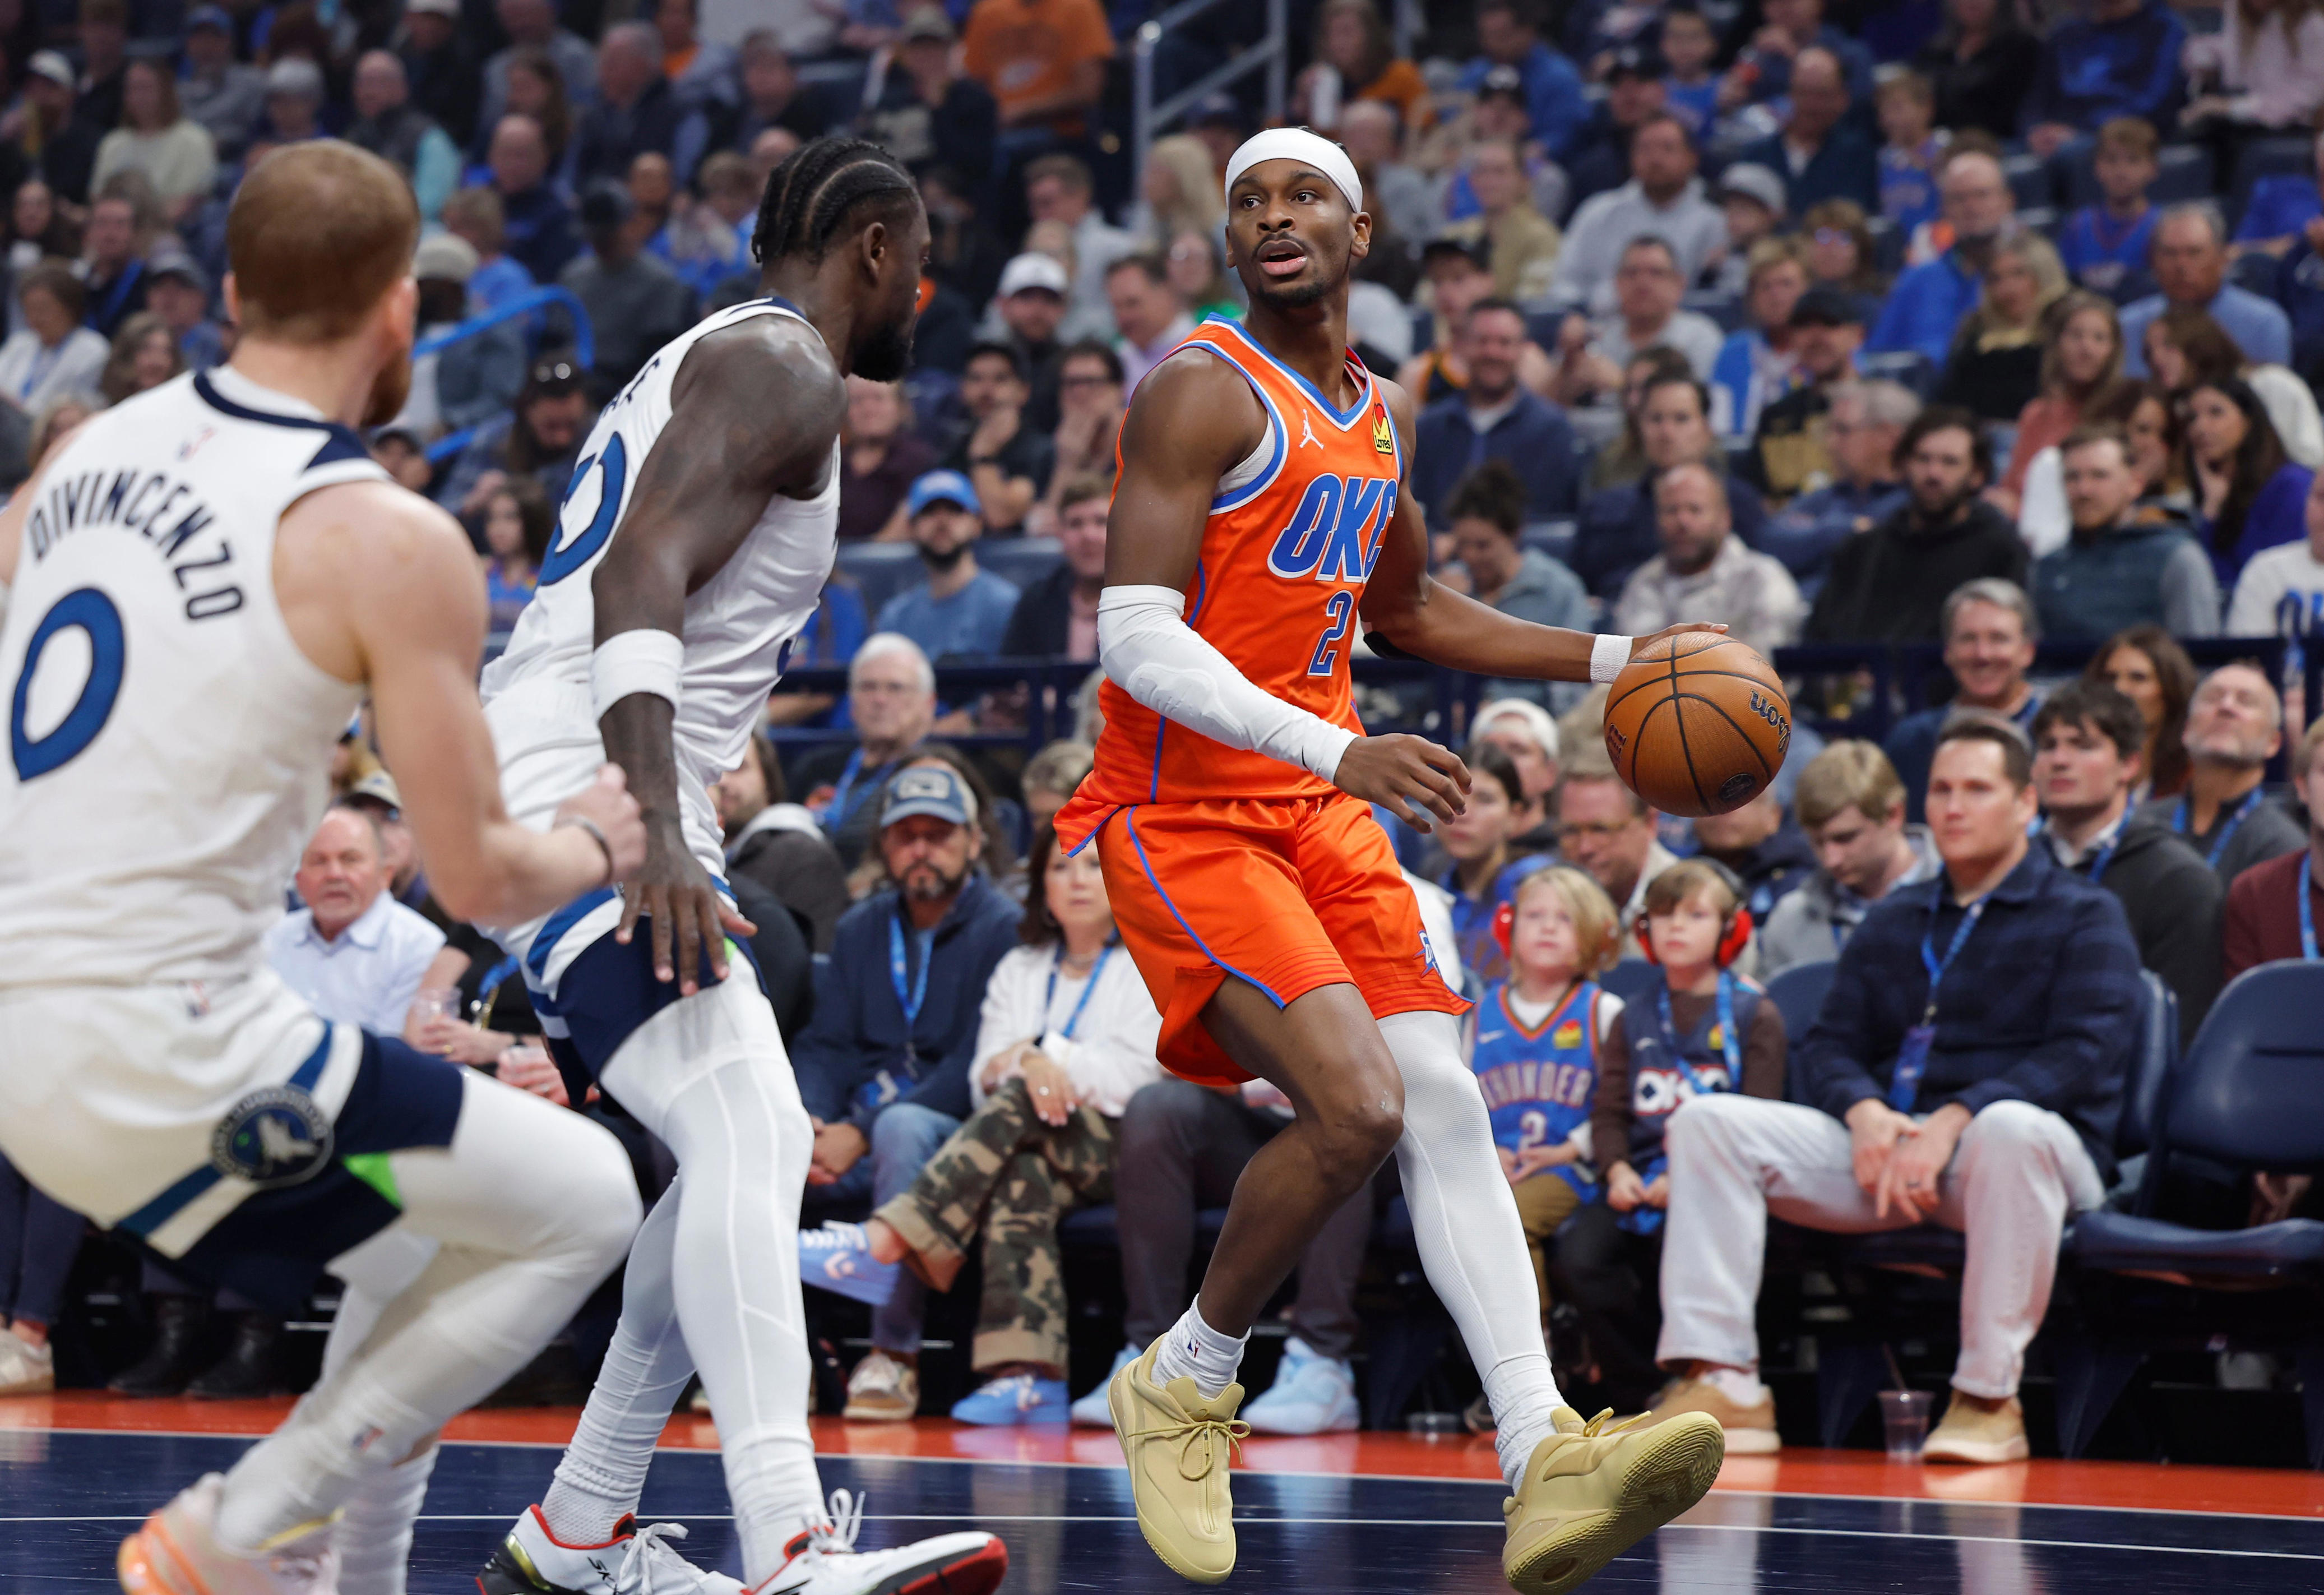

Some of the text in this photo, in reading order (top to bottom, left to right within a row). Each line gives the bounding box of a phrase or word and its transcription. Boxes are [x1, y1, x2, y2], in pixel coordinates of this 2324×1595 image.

[29, 469, 244, 620] DIVINCENZO
[1267, 473, 1397, 584] OKC
[11, 586, 124, 782] 0
[1307, 590, 1354, 676] 2
[1519, 1111, 1548, 1152] 2
